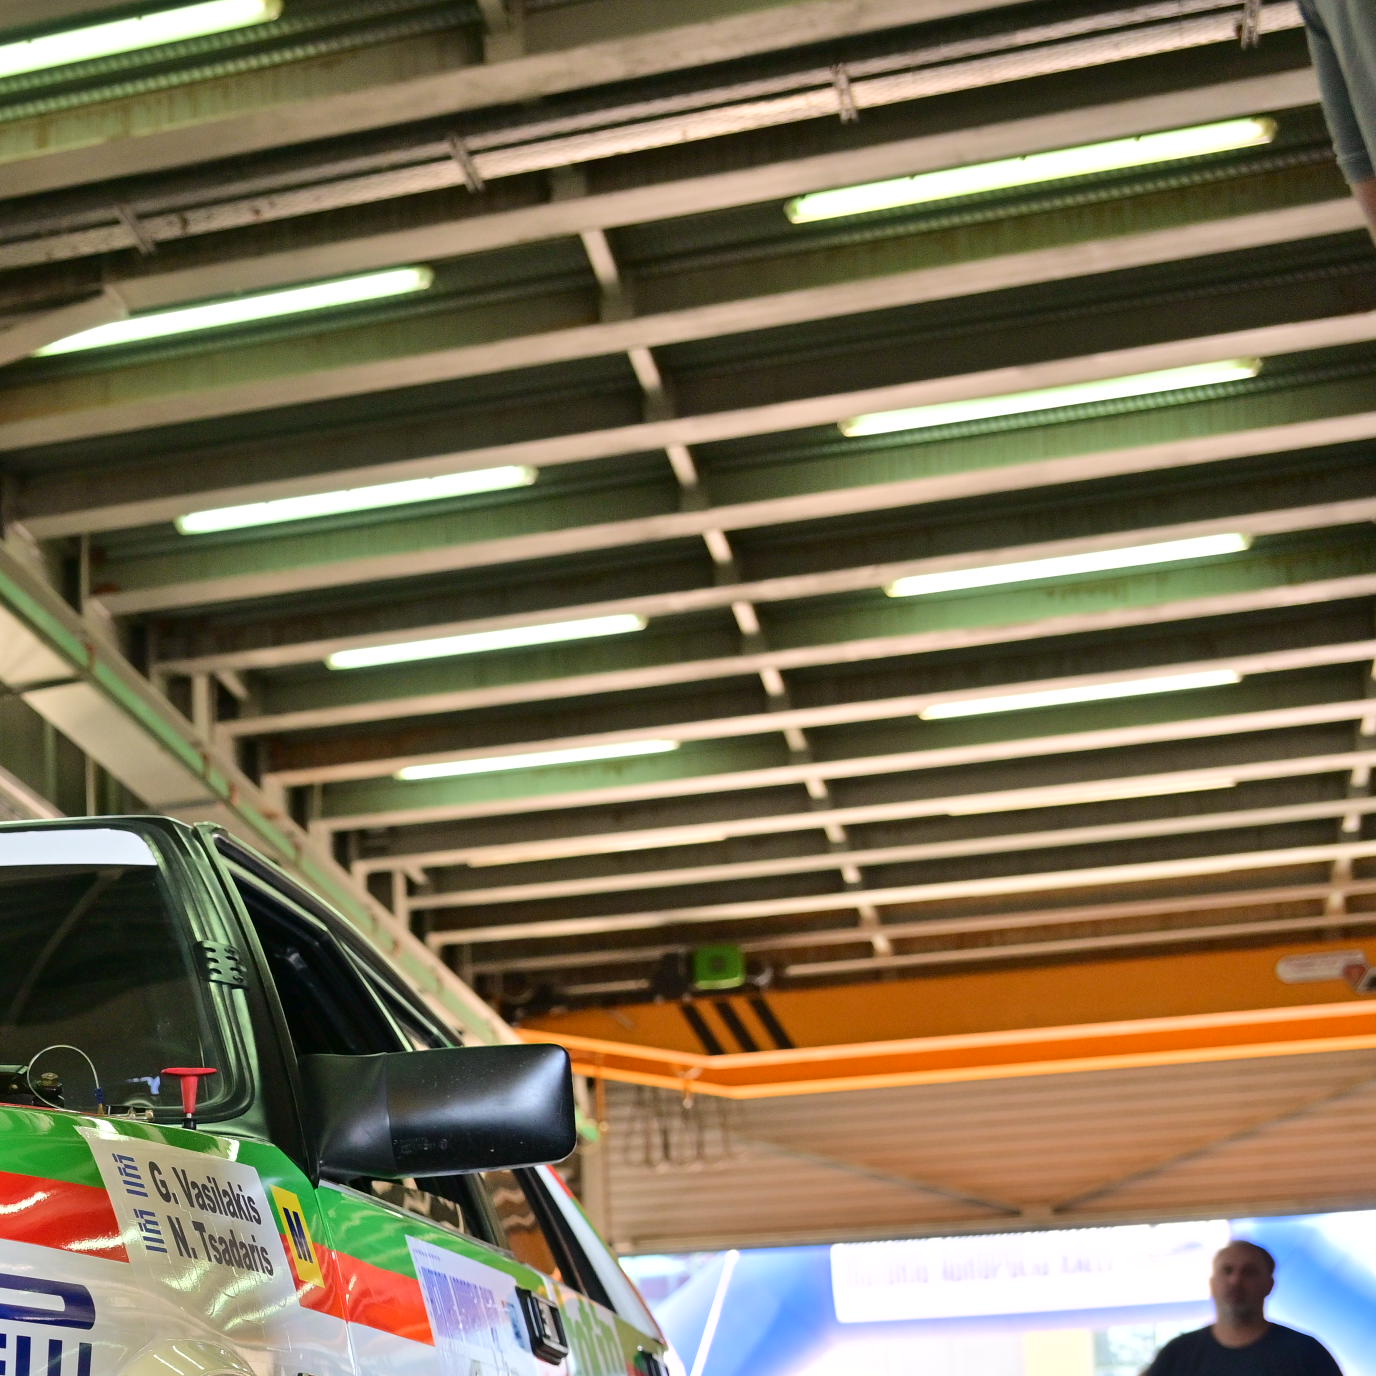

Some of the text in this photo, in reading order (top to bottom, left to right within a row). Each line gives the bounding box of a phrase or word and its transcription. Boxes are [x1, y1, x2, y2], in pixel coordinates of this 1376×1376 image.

[148, 1160, 262, 1225] G. Vasilakis
[166, 1215, 274, 1277] N. Tsadaris
[282, 1206, 314, 1264] M
